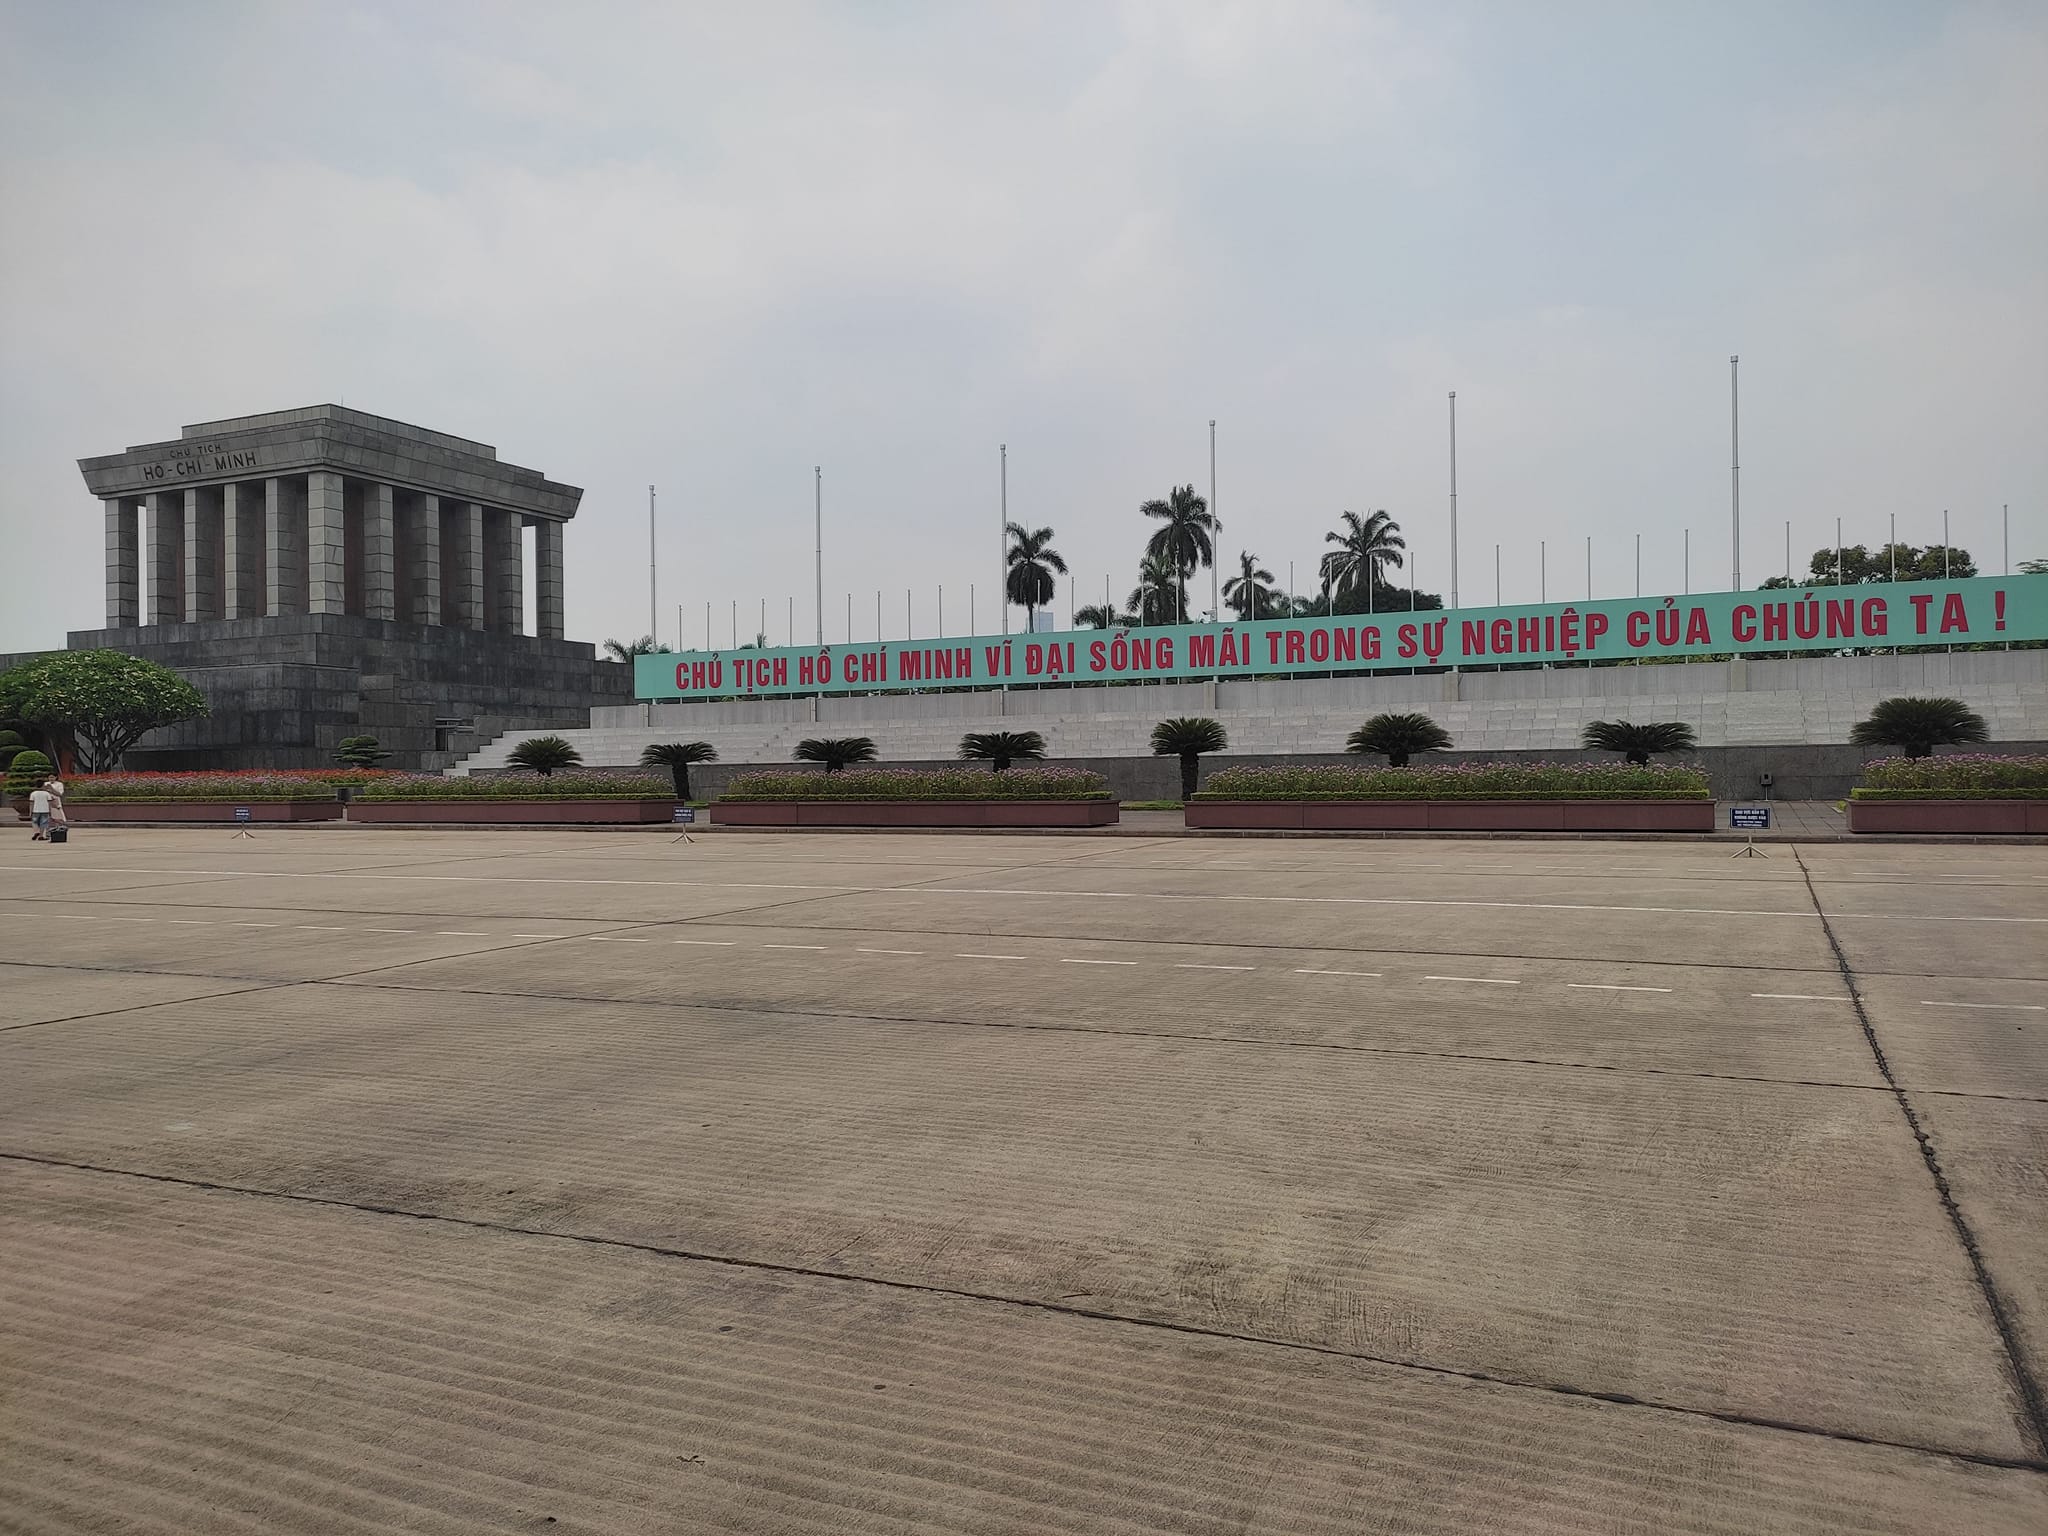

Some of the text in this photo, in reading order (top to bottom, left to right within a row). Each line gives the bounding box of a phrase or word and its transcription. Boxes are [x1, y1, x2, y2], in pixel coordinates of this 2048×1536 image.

[676, 654, 722, 690] CHỦ
[734, 656, 786, 692] TỊCH
[800, 647, 831, 685] HỒ
[844, 646, 887, 683] CHÍ
[900, 648, 971, 680] MINH
[986, 640, 1011, 678] VĨ
[1026, 642, 1075, 680] ĐẠI
[1091, 630, 1174, 672] SỐNG
[1190, 627, 1250, 668] MÃI
[1267, 626, 1381, 664] TRONG
[1398, 617, 1449, 664] SỰ
[1463, 608, 1609, 658] NGHIỆP
[1627, 597, 1711, 648] CỦA
[1732, 592, 1888, 643] CHÚNG
[1910, 594, 1969, 634] TA
